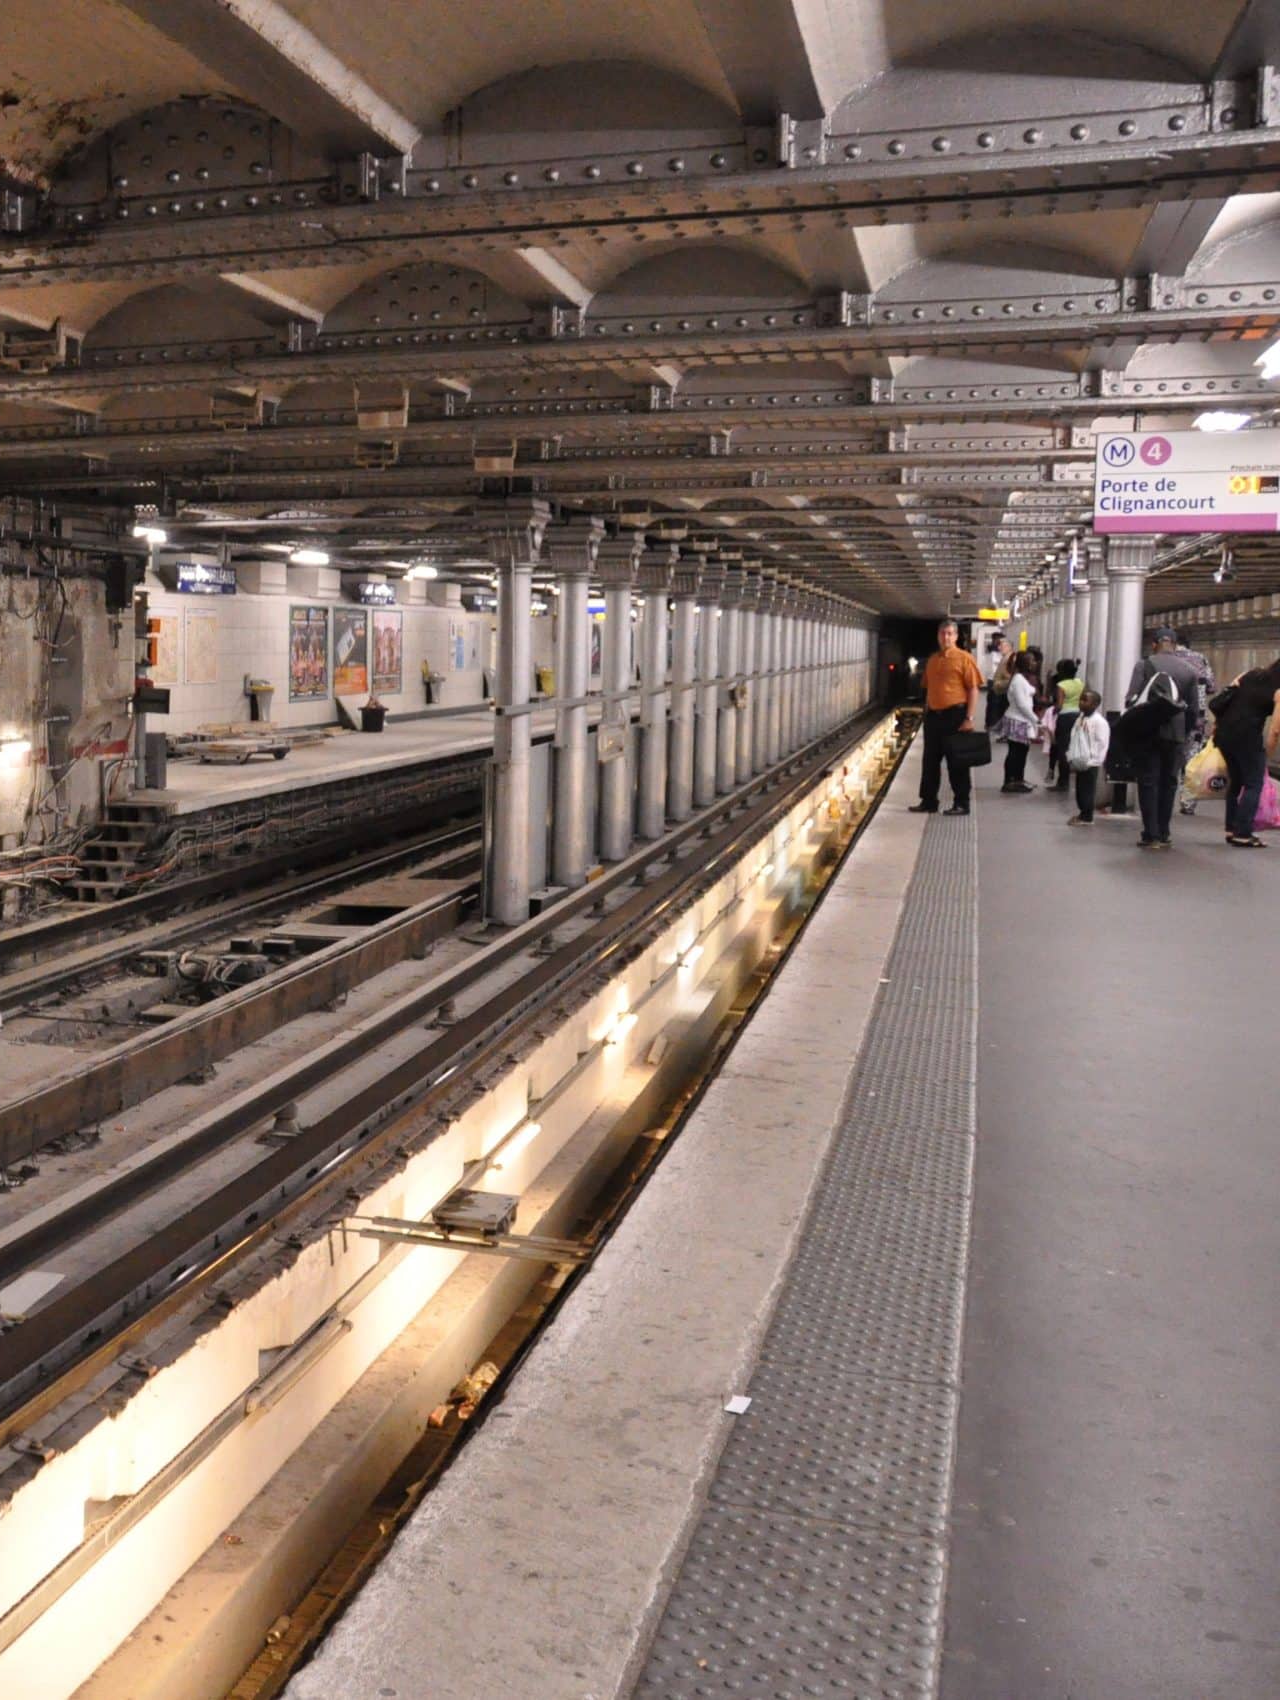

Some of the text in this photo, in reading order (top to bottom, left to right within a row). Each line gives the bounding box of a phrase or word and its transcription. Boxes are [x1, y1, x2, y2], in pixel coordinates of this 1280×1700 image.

[1146, 442, 1163, 461] 4
[1101, 477, 1177, 493] Porte de
[1100, 496, 1216, 513] Clignancourt
